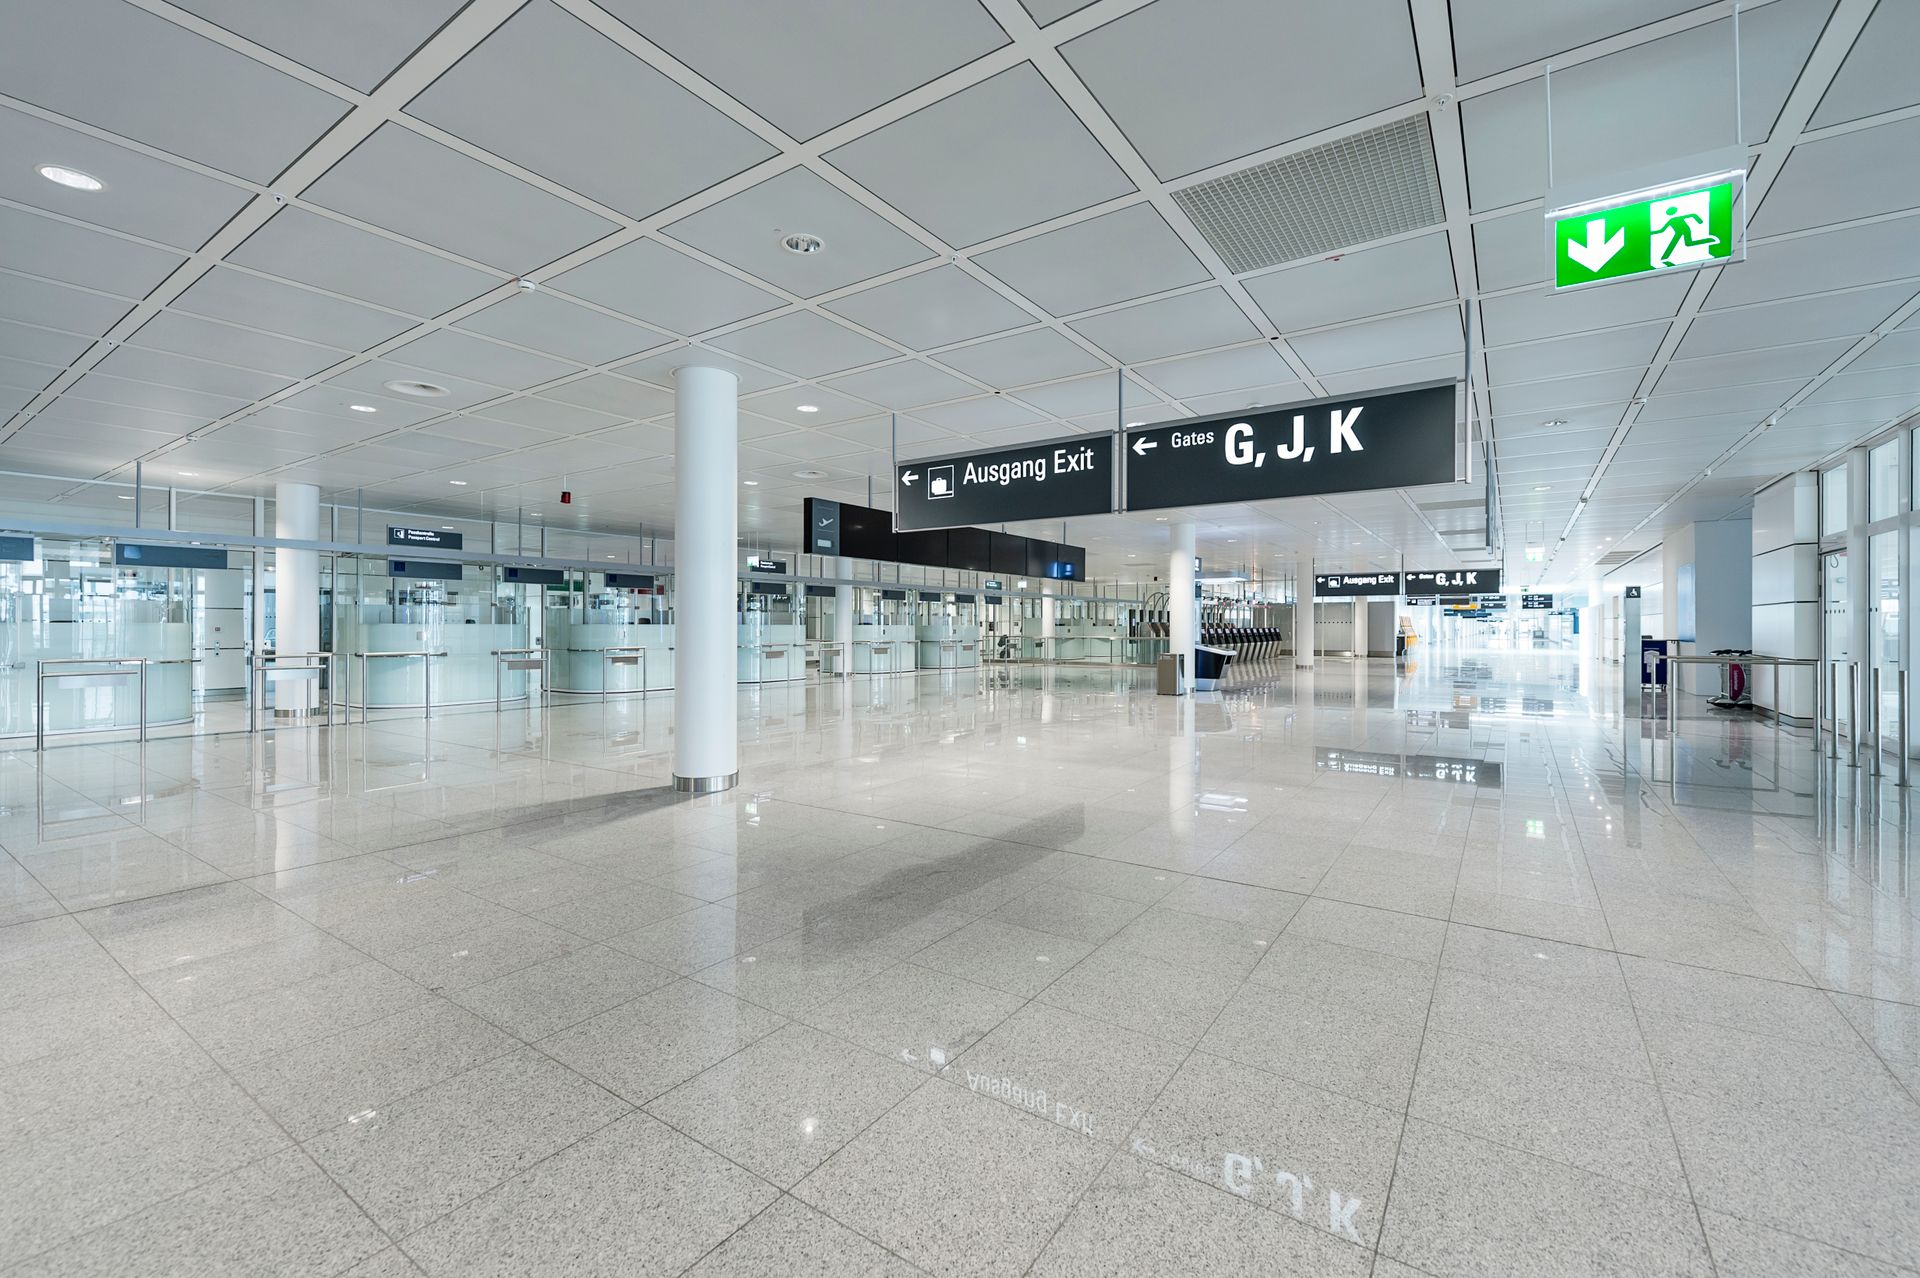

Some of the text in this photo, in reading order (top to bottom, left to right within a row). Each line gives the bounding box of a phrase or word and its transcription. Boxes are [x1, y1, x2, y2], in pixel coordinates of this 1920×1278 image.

[1171, 406, 1364, 469] Gates G, J, K
[962, 446, 1095, 487] Ausgang Exit
[1342, 574, 1395, 586] Ausgang Exit
[1435, 572, 1450, 588] G,
[1451, 572, 1465, 587] J,
[1465, 571, 1478, 585] K
